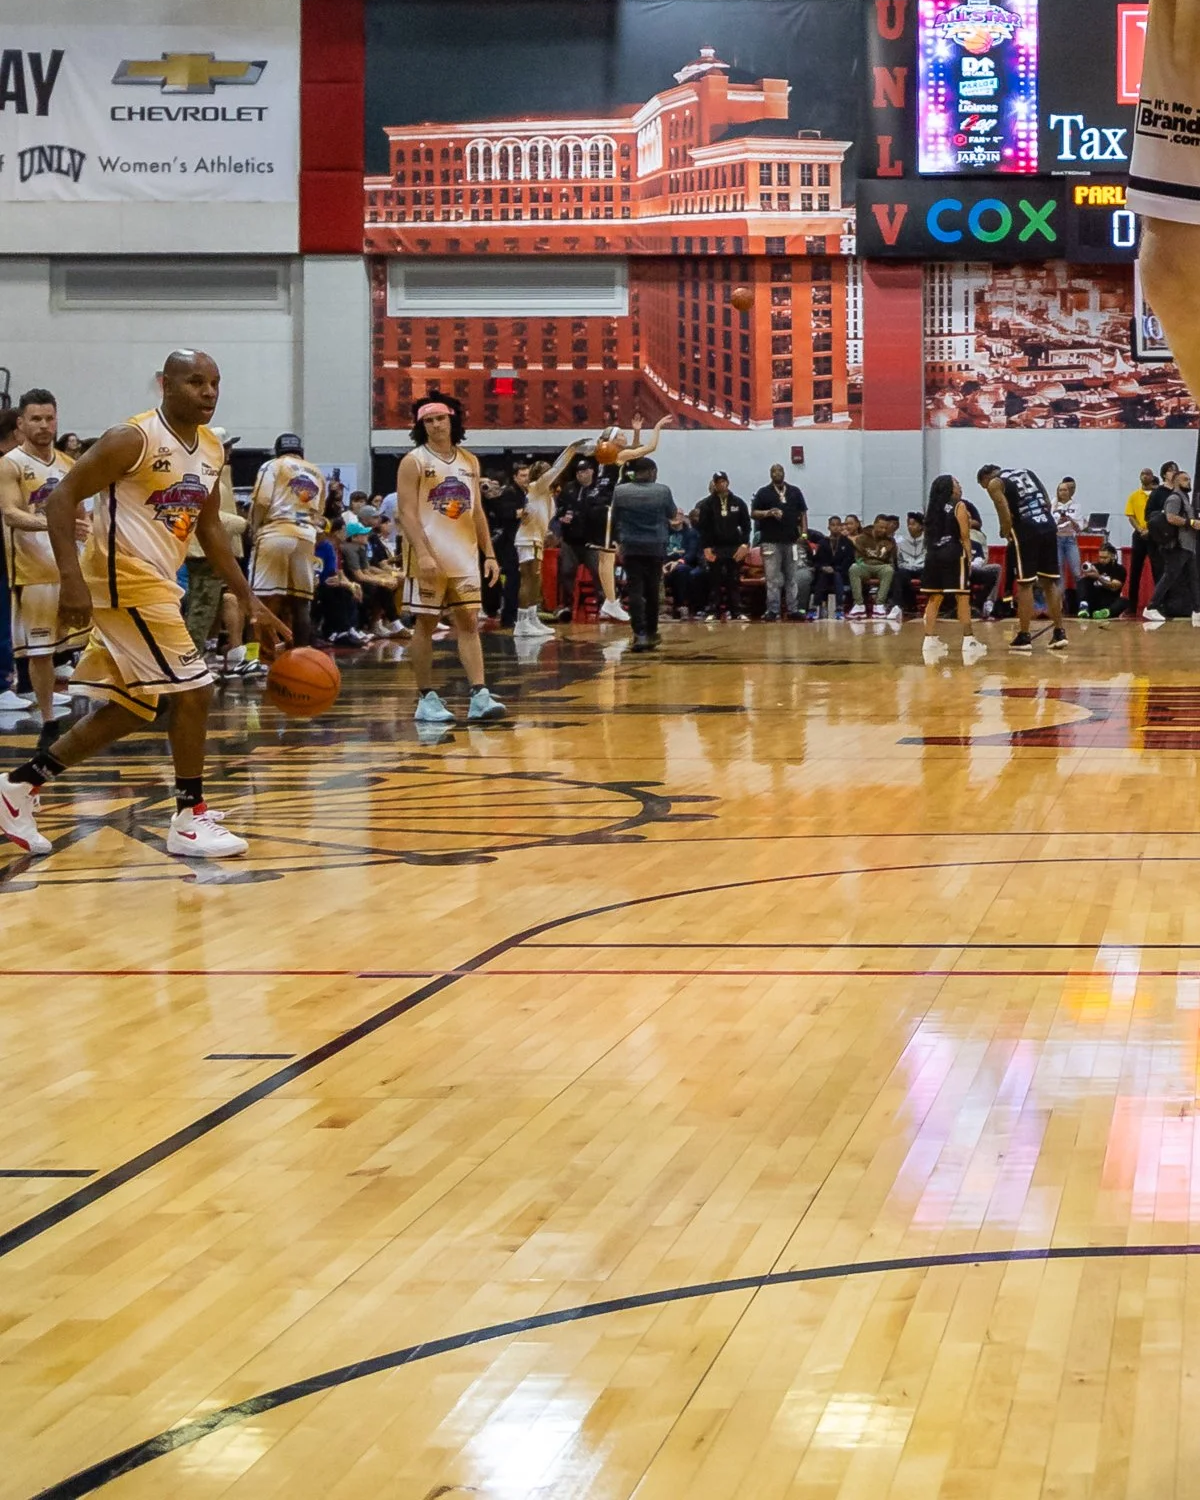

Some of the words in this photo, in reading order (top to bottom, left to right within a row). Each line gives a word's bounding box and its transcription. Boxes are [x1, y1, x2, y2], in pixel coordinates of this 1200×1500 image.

[110, 106, 268, 122] CHEVROLET
[1154, 99, 1169, 111] It's
[1172, 102, 1192, 115] Me
[1050, 114, 1128, 160] Tax
[18, 144, 87, 183] UNLV
[99, 156, 187, 174] Women's
[194, 155, 274, 174] Athletics
[957, 153, 1000, 164] JARDIN
[926, 198, 1057, 243] COX
[1113, 210, 1135, 247] 0
